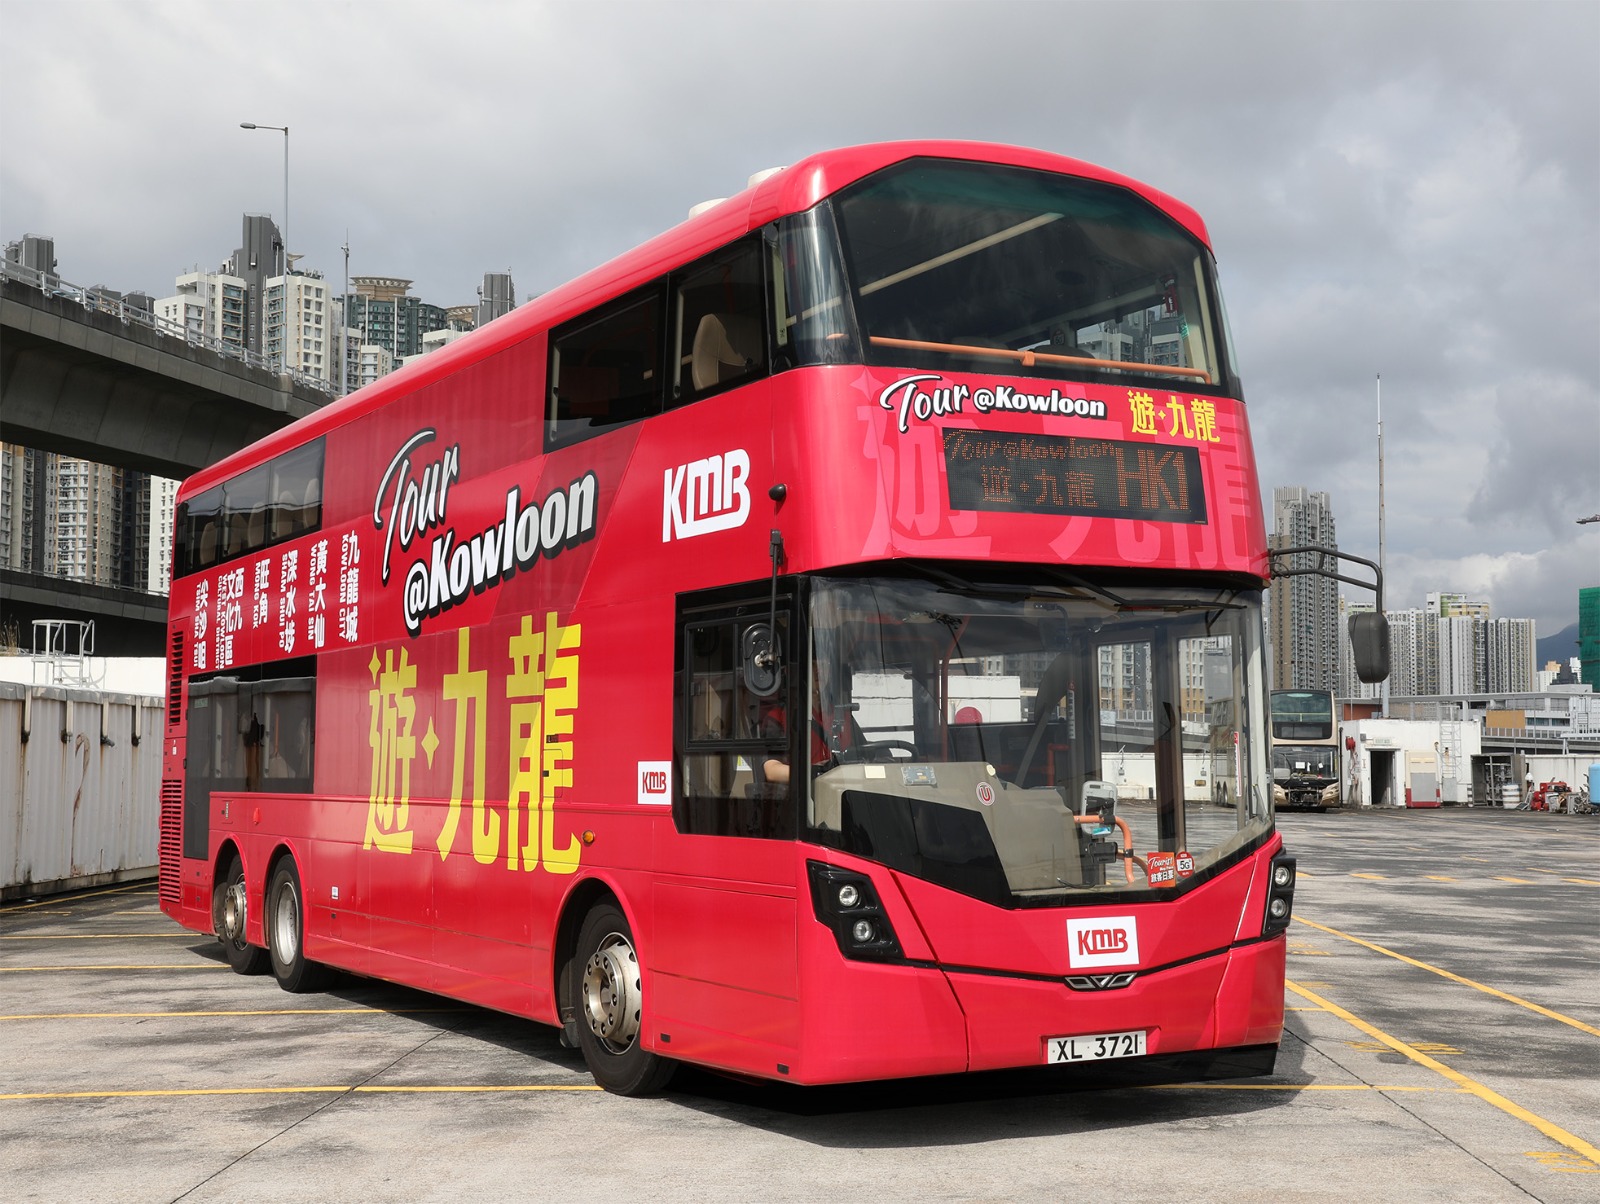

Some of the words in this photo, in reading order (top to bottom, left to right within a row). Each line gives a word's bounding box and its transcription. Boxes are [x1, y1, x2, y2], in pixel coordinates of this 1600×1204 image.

[880, 374, 970, 433] Tour
[973, 385, 1107, 420] @Kowloon
[662, 448, 751, 543] KMB
[1115, 447, 1190, 510] HK1
[374, 428, 460, 583] Tour
[280, 553, 288, 593] SHAM
[309, 543, 318, 586] WONG
[339, 533, 349, 604] KOWLOON
[403, 472, 598, 634] @Kowloon
[253, 562, 261, 601] MONG
[258, 558, 270, 625] 旺角
[285, 549, 298, 654] 深水埗
[308, 590, 316, 613] TAI
[345, 529, 361, 643] 九龍城
[198, 578, 209, 669] 尖沙咀
[278, 631, 285, 648] PO
[307, 617, 315, 641] SIN
[338, 608, 346, 640] CITY
[642, 771, 667, 794] KMB
[1077, 928, 1129, 956] KMB
[1056, 1040, 1083, 1061] XL
[1093, 1034, 1139, 1058] 3721
